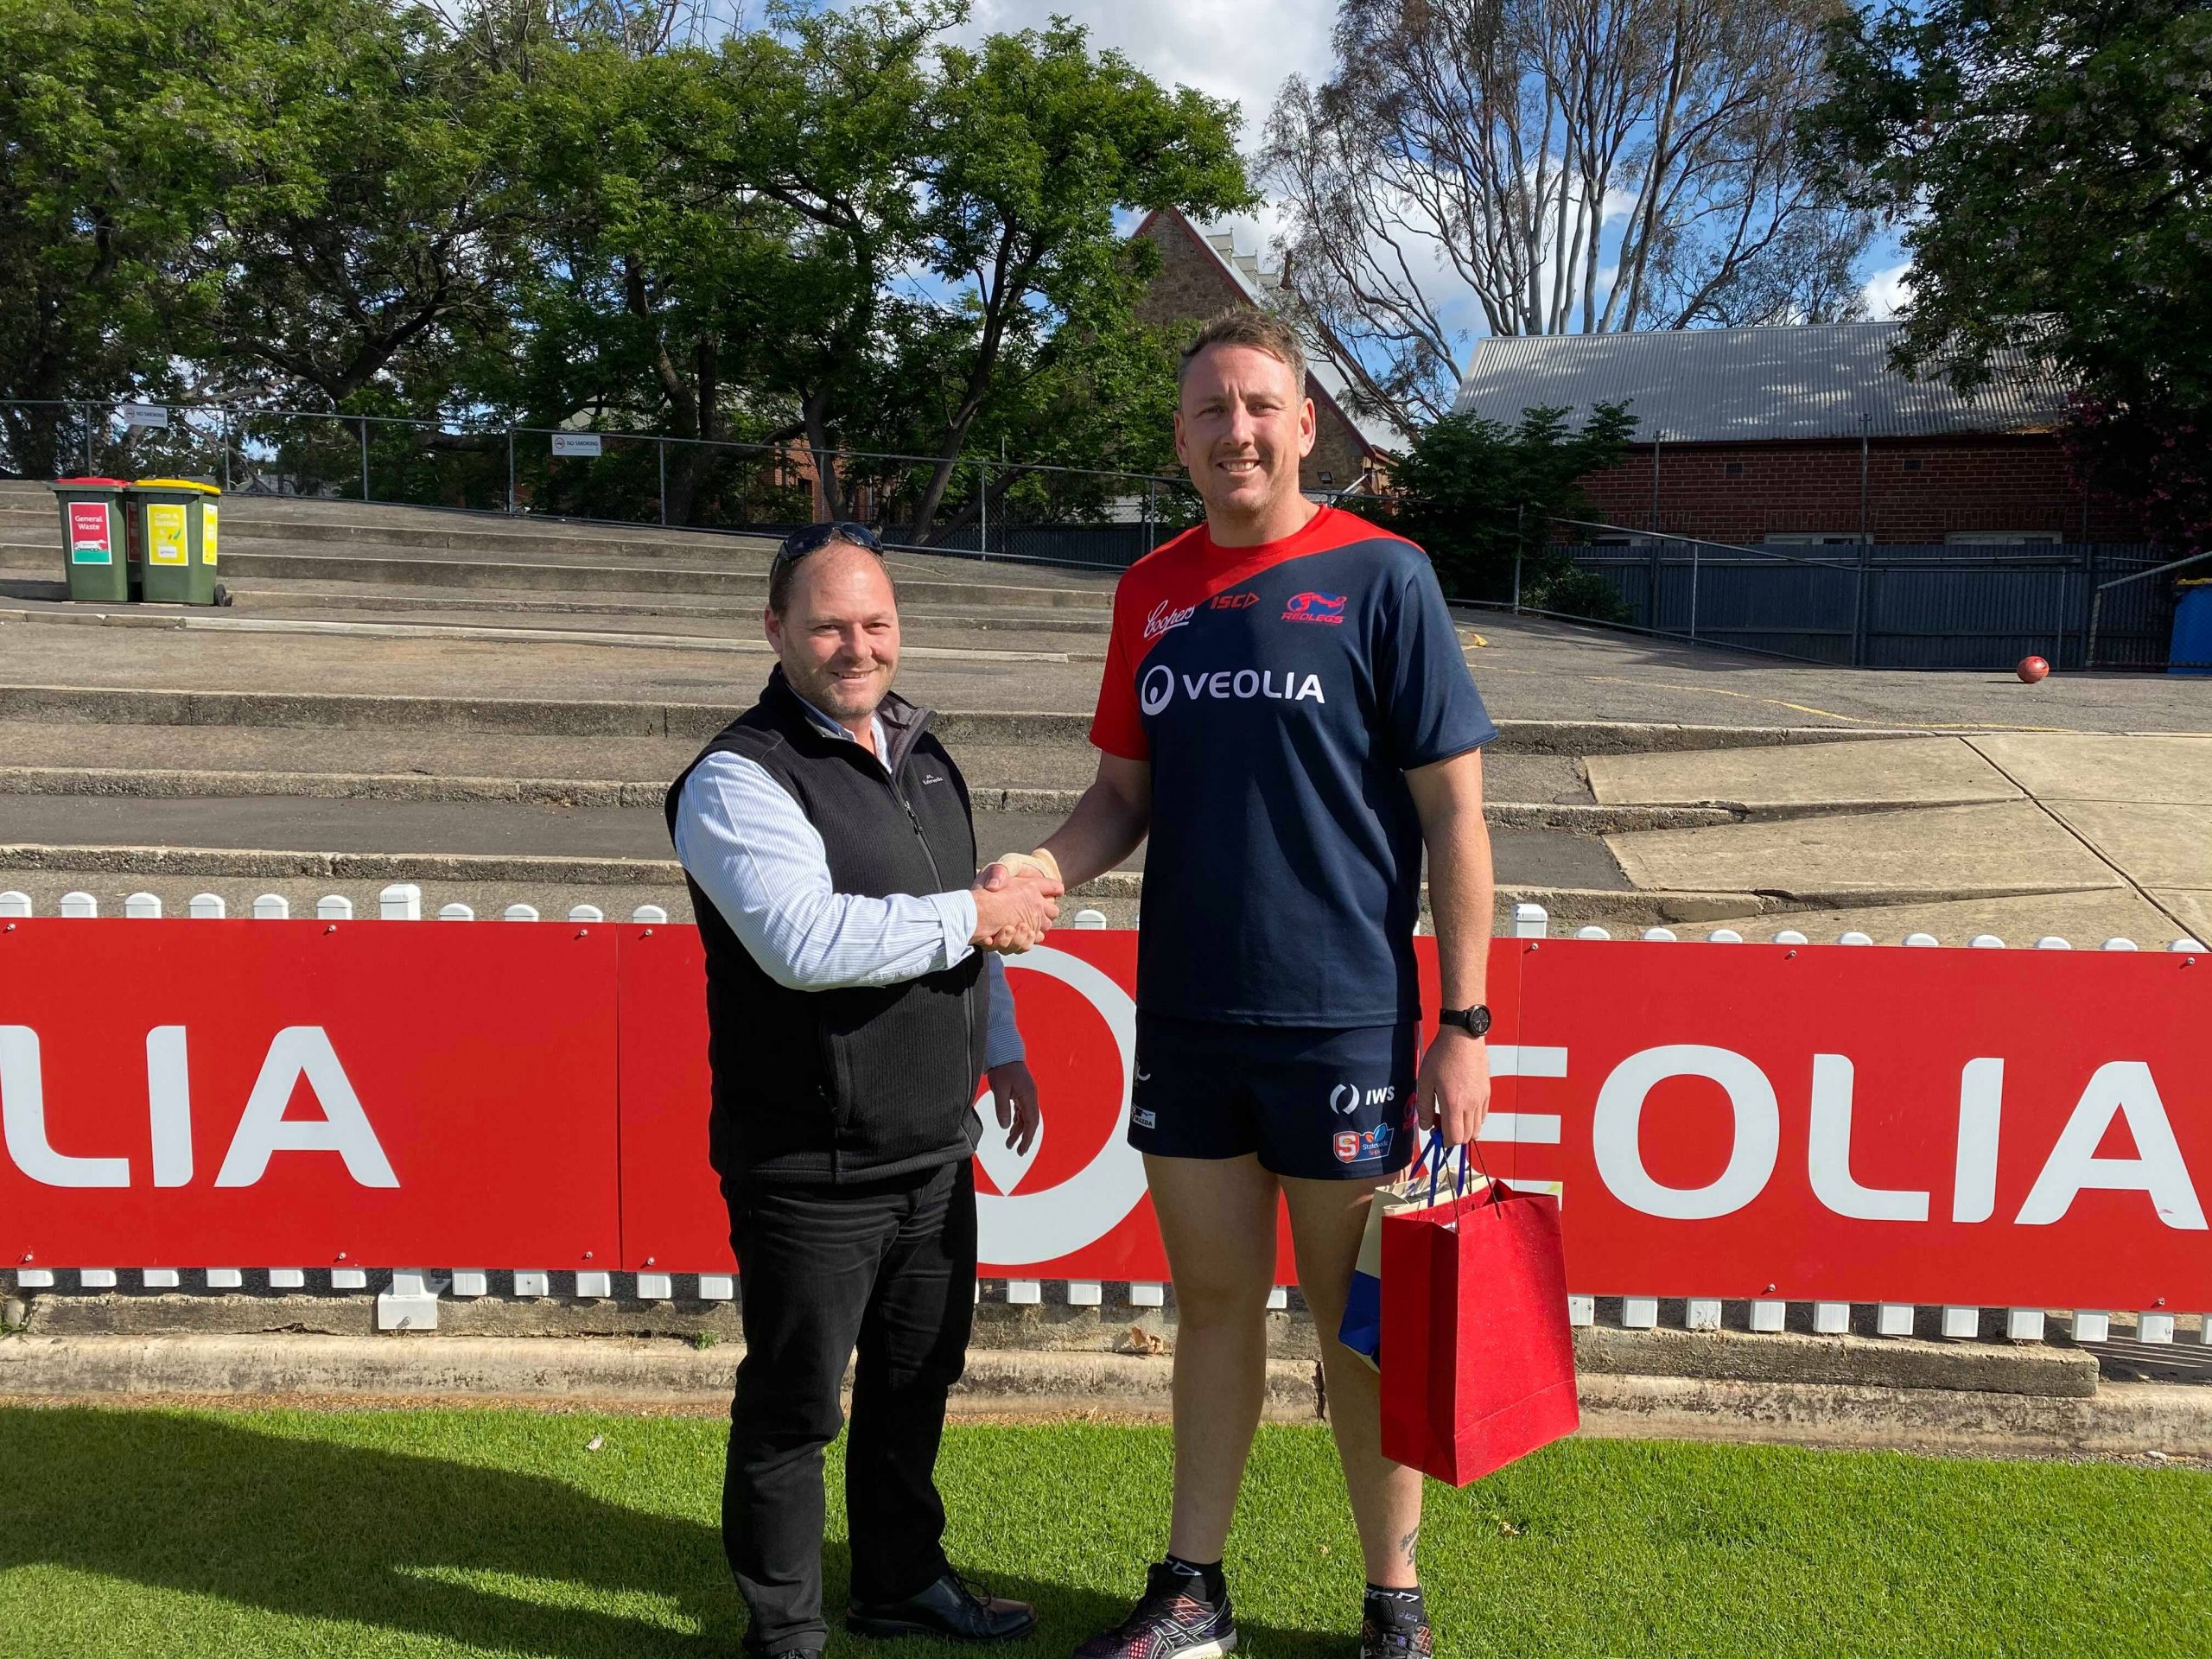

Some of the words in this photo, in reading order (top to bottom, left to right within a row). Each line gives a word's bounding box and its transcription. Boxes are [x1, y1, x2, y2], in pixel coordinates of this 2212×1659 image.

[1281, 612, 1344, 624] REDLEGS
[1182, 669, 1325, 705] VEOLIA
[1365, 1085, 1395, 1106] IWS
[1135, 1116, 1154, 1128] MAZDA
[1418, 1044, 2209, 1230] EOLIA
